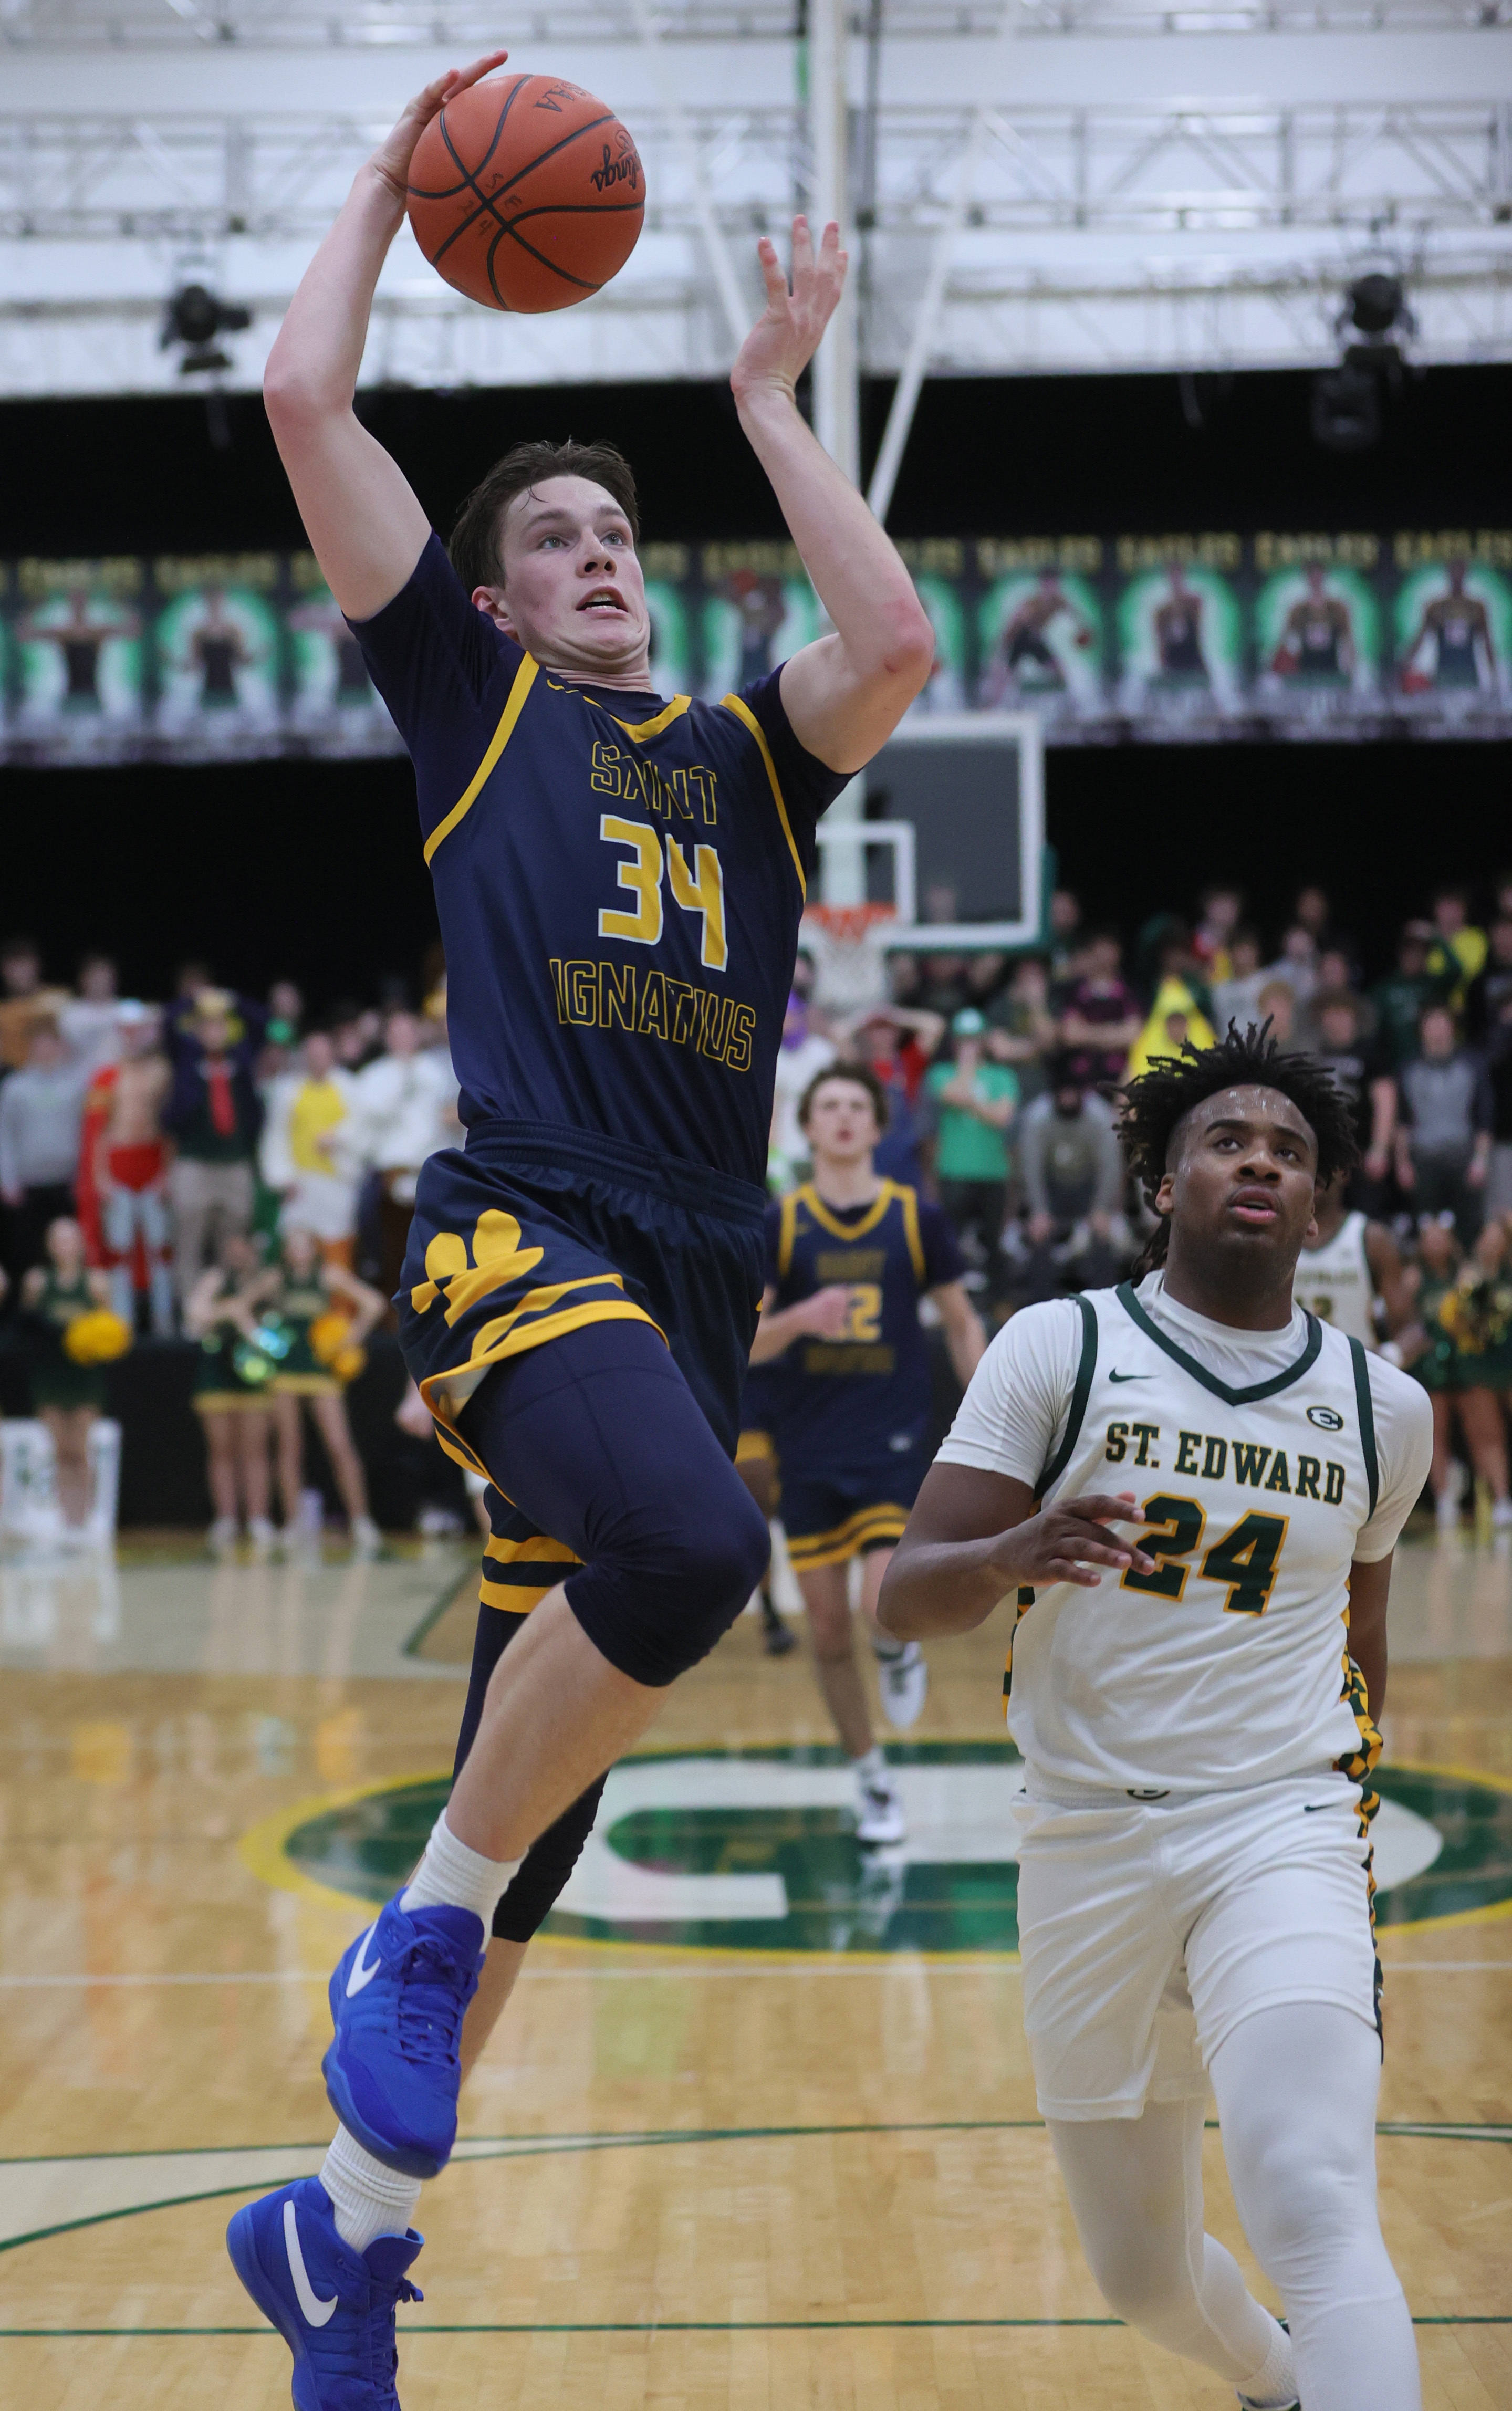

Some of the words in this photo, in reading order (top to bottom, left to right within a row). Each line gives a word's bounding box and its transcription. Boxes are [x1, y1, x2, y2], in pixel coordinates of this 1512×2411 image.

[591, 740, 717, 825] SAINT
[598, 813, 728, 972] 34
[549, 958, 755, 1072] IGNATIUS
[1105, 1422, 1161, 1468] ST.
[1174, 1429, 1347, 1506] EDWARD
[1119, 1491, 1290, 1617] 24
